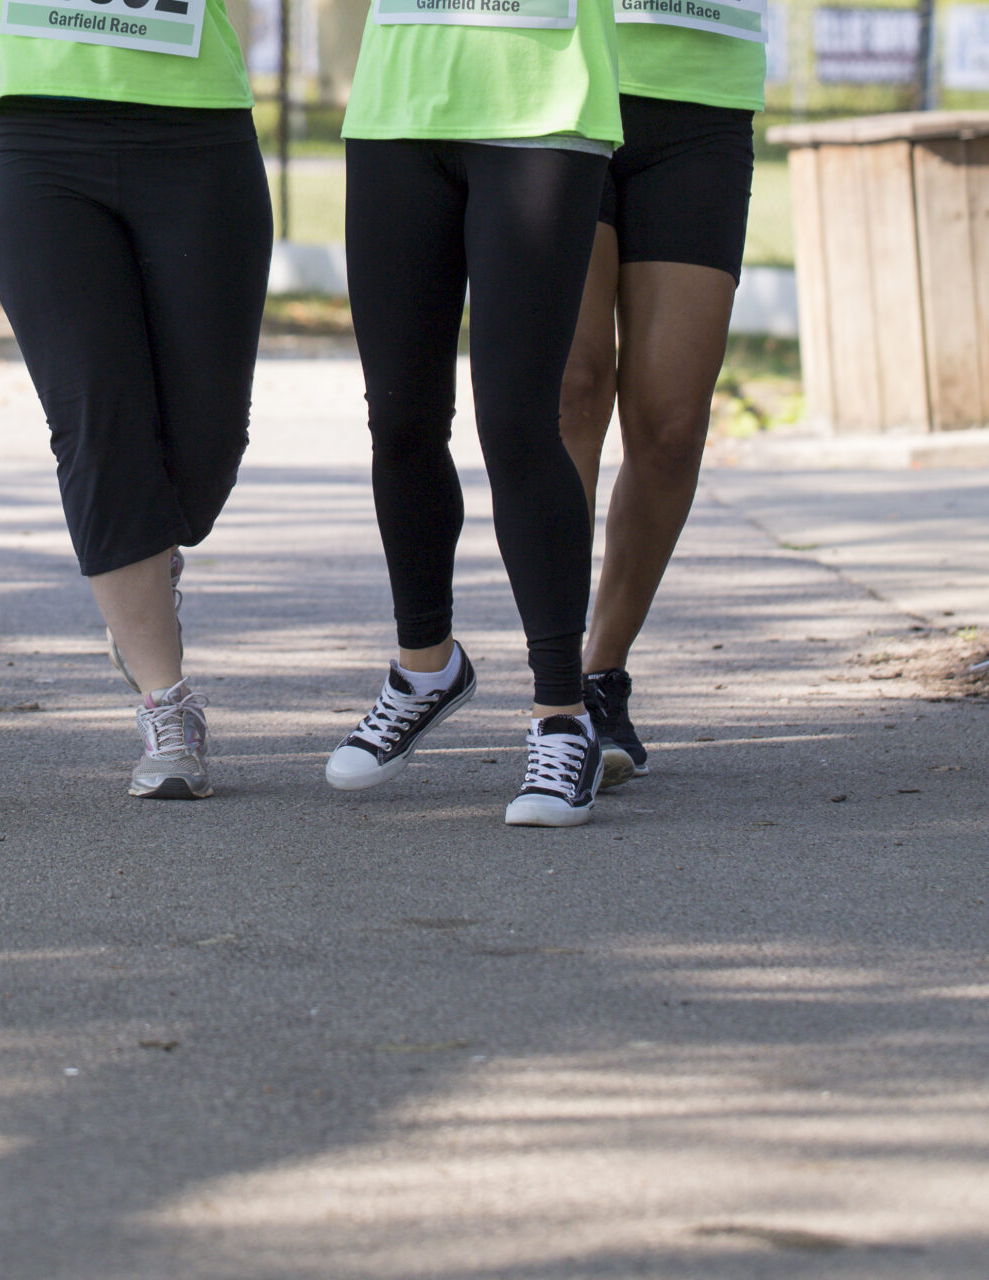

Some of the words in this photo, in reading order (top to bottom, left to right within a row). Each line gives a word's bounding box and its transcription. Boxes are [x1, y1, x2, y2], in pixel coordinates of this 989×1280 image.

[686, 2, 720, 20] Race
[49, 10, 106, 31] Garfield
[110, 17, 147, 35] Race
